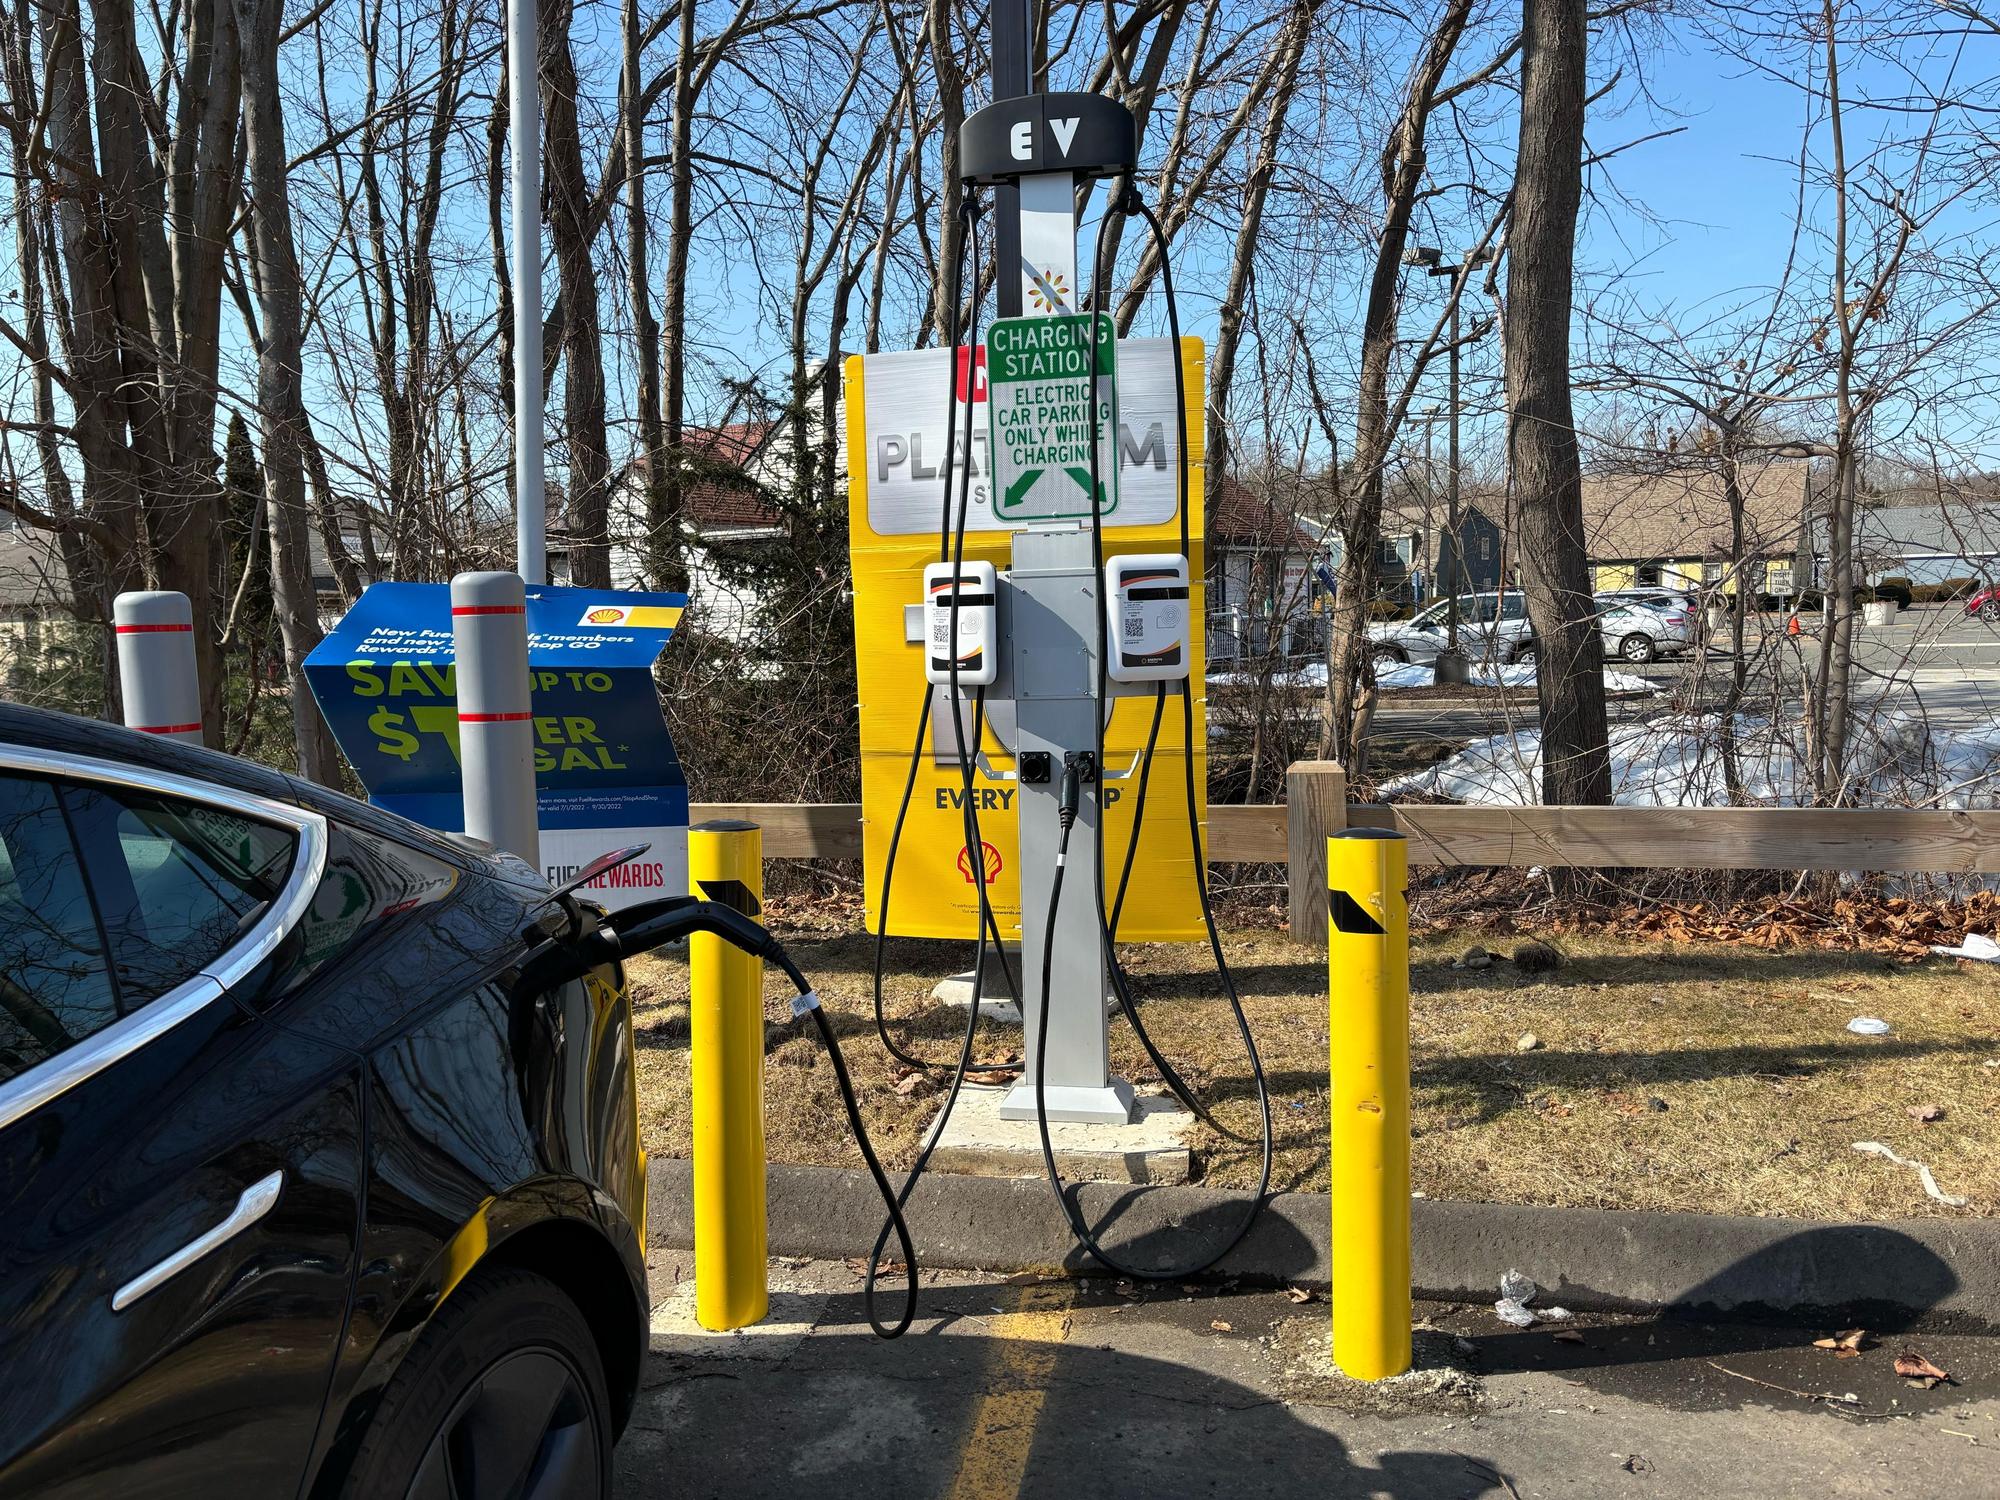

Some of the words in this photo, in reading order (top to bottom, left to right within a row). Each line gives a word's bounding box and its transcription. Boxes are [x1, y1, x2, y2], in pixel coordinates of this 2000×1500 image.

[994, 321, 1108, 351] CHARGING
[1015, 384, 1090, 405] ELECTRIC
[998, 408, 1031, 426] CAR
[1038, 402, 1110, 424] PARKIG
[1005, 427, 1049, 446] ONLY
[1055, 423, 1105, 443] WHILE
[877, 422, 1167, 483] PLATM
[363, 637, 402, 645] and
[528, 641, 564, 650] hop
[568, 641, 601, 649] GO
[371, 627, 417, 637] New
[547, 634, 635, 643] members
[345, 659, 457, 697] SAV
[565, 672, 613, 692] TO
